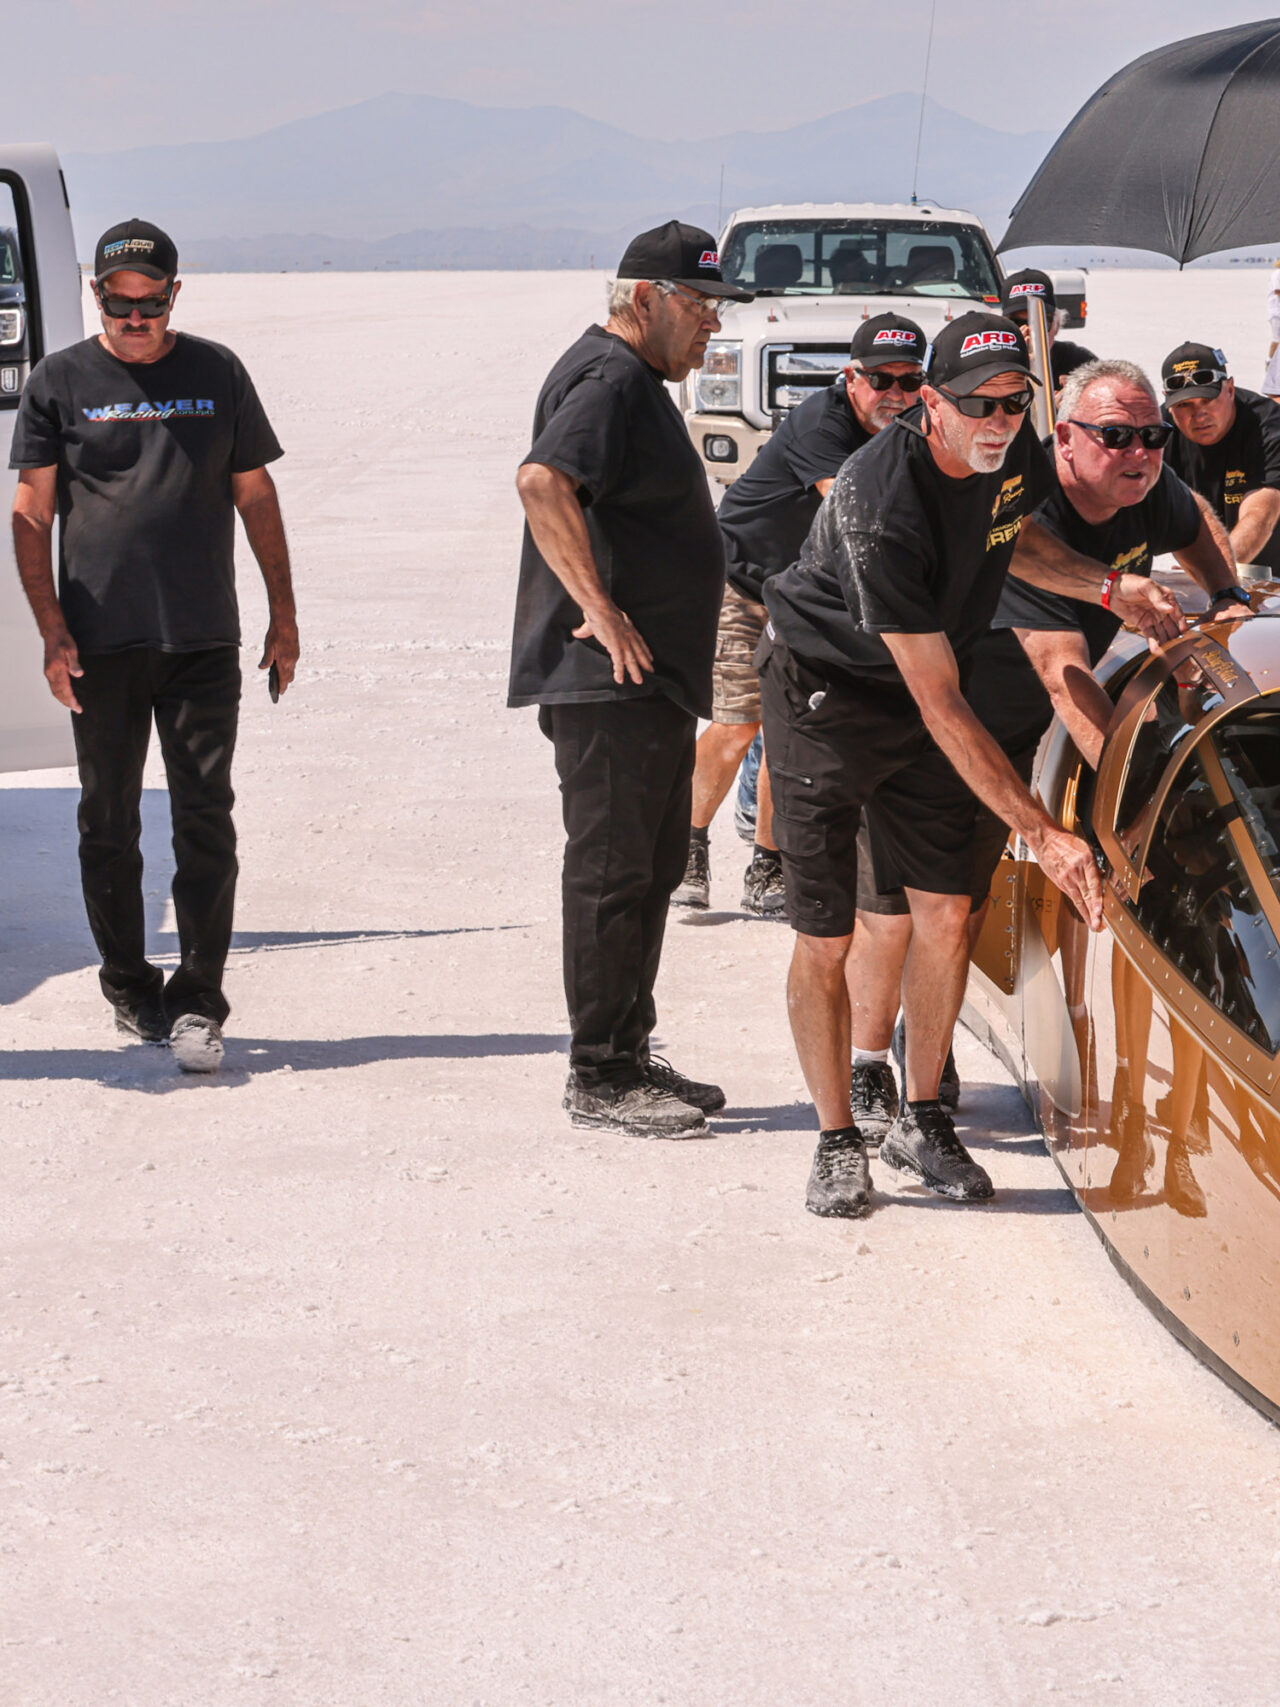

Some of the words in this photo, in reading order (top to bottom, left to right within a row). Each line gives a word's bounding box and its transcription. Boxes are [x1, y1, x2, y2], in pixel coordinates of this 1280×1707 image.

[1009, 283, 1046, 298] ARP
[873, 329, 917, 343] ARP
[960, 330, 1017, 354] ARP
[82, 399, 214, 420] WEAVER
[104, 408, 176, 421] Racing
